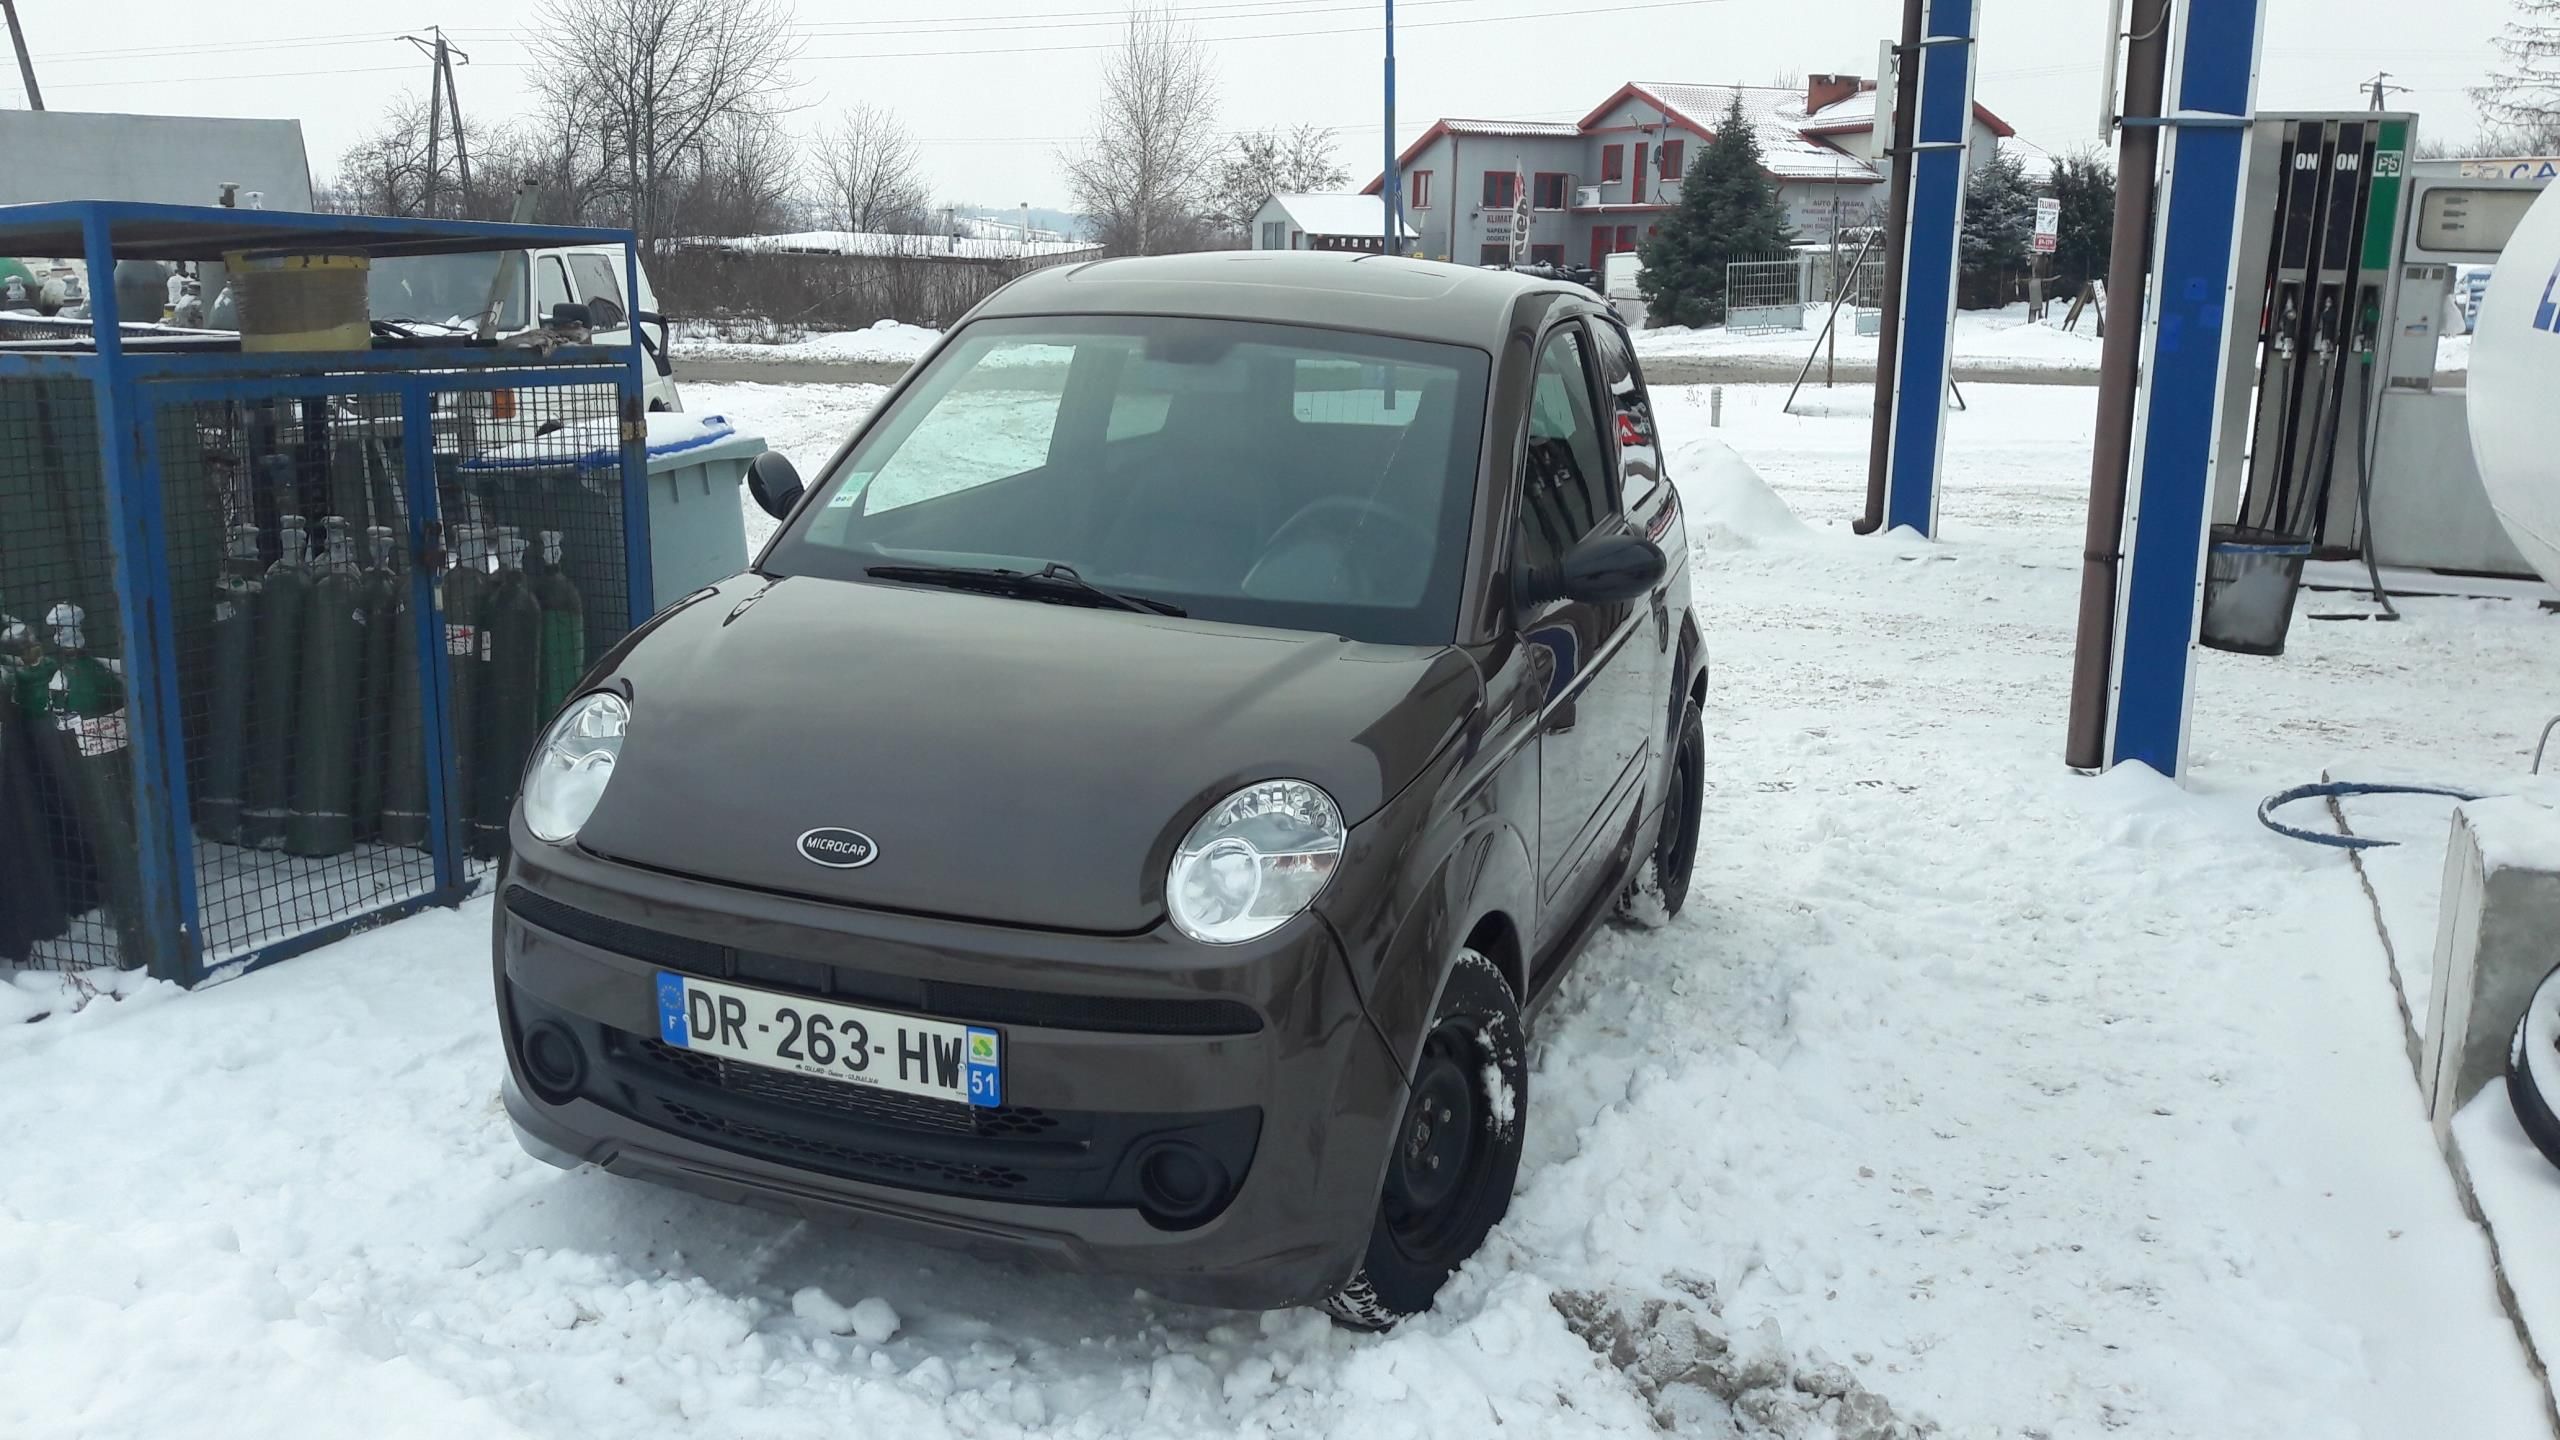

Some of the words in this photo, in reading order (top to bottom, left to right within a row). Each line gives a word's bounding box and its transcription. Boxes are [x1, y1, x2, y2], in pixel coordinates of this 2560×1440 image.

[2295, 153, 2318, 170] ON
[2336, 153, 2359, 171] ON
[806, 836, 867, 857] MICROCAR
[668, 1015, 677, 1030] F
[688, 988, 962, 1090] DR-263-HW
[972, 1070, 994, 1097] 51
